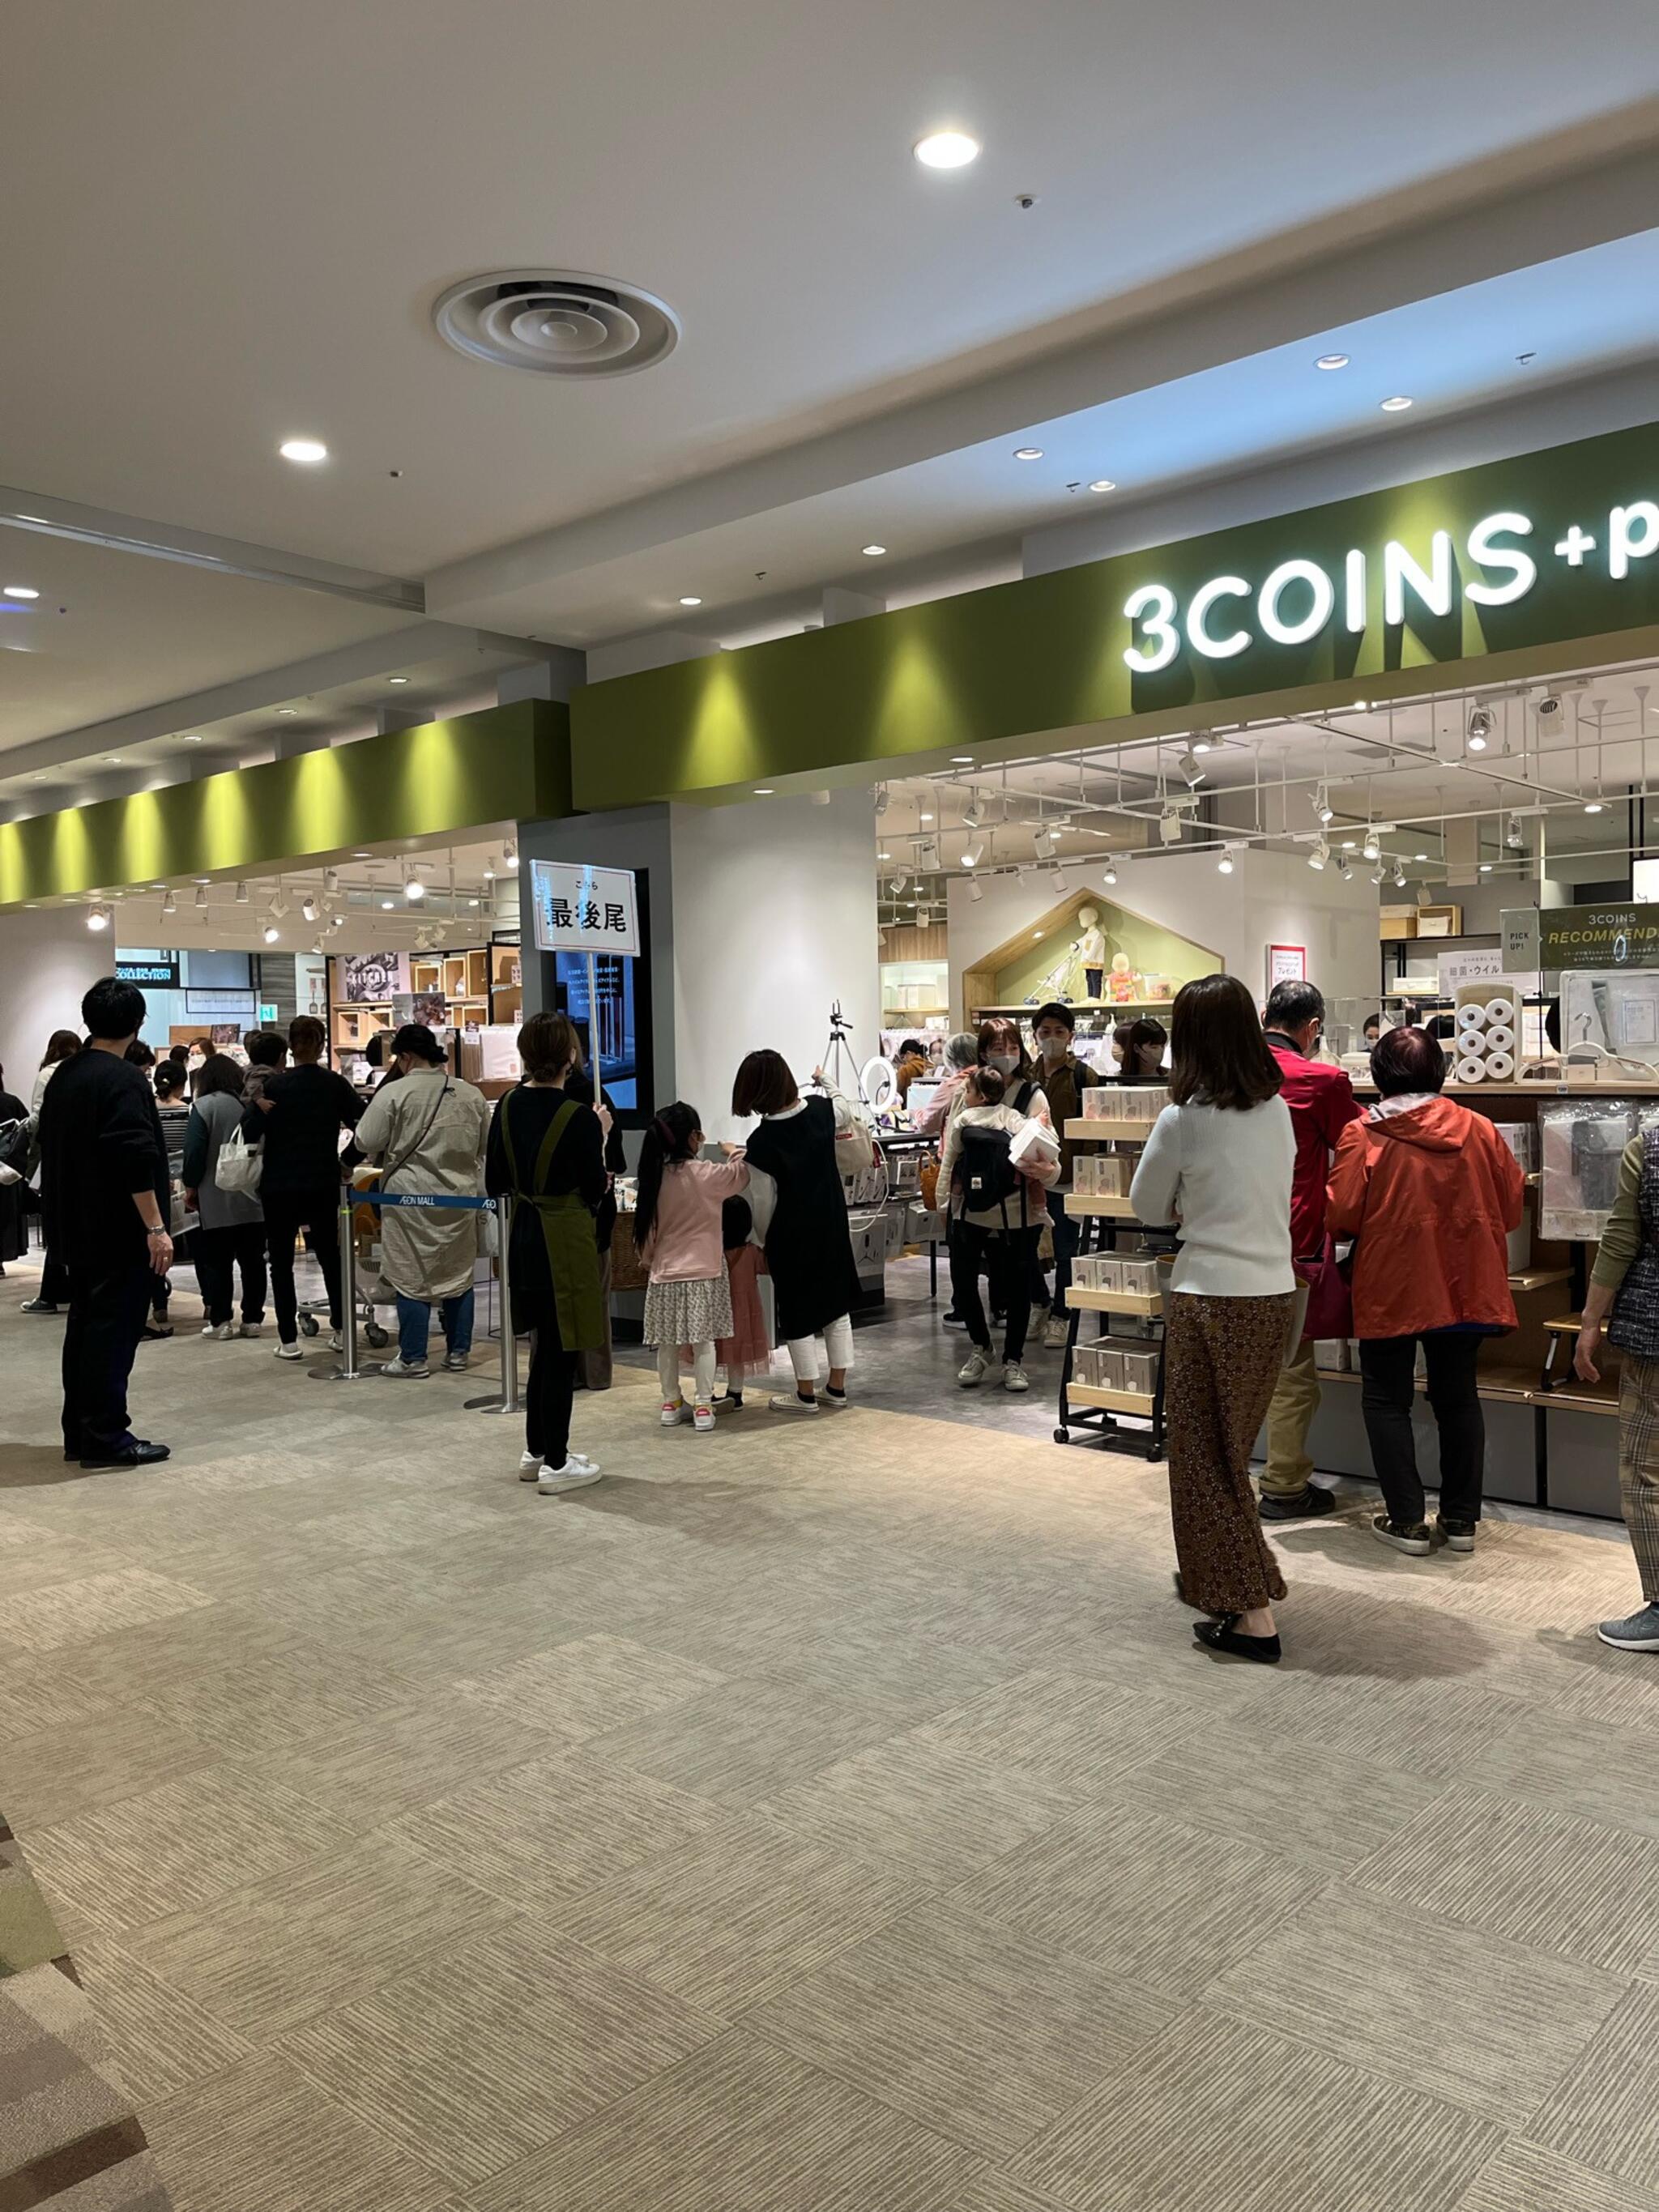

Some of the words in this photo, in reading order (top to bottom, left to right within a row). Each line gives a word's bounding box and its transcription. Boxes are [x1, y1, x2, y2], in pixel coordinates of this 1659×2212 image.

[1123, 512, 1537, 673] 3COINS
[575, 880, 599, 891] こら
[546, 897, 627, 933] 最後尾
[1589, 913, 1637, 925] 3COINS
[1510, 931, 1529, 940] PICK
[1548, 927, 1659, 944] RECOMMEND
[1510, 943, 1525, 951] UP!
[417, 1196, 435, 1206] MALL
